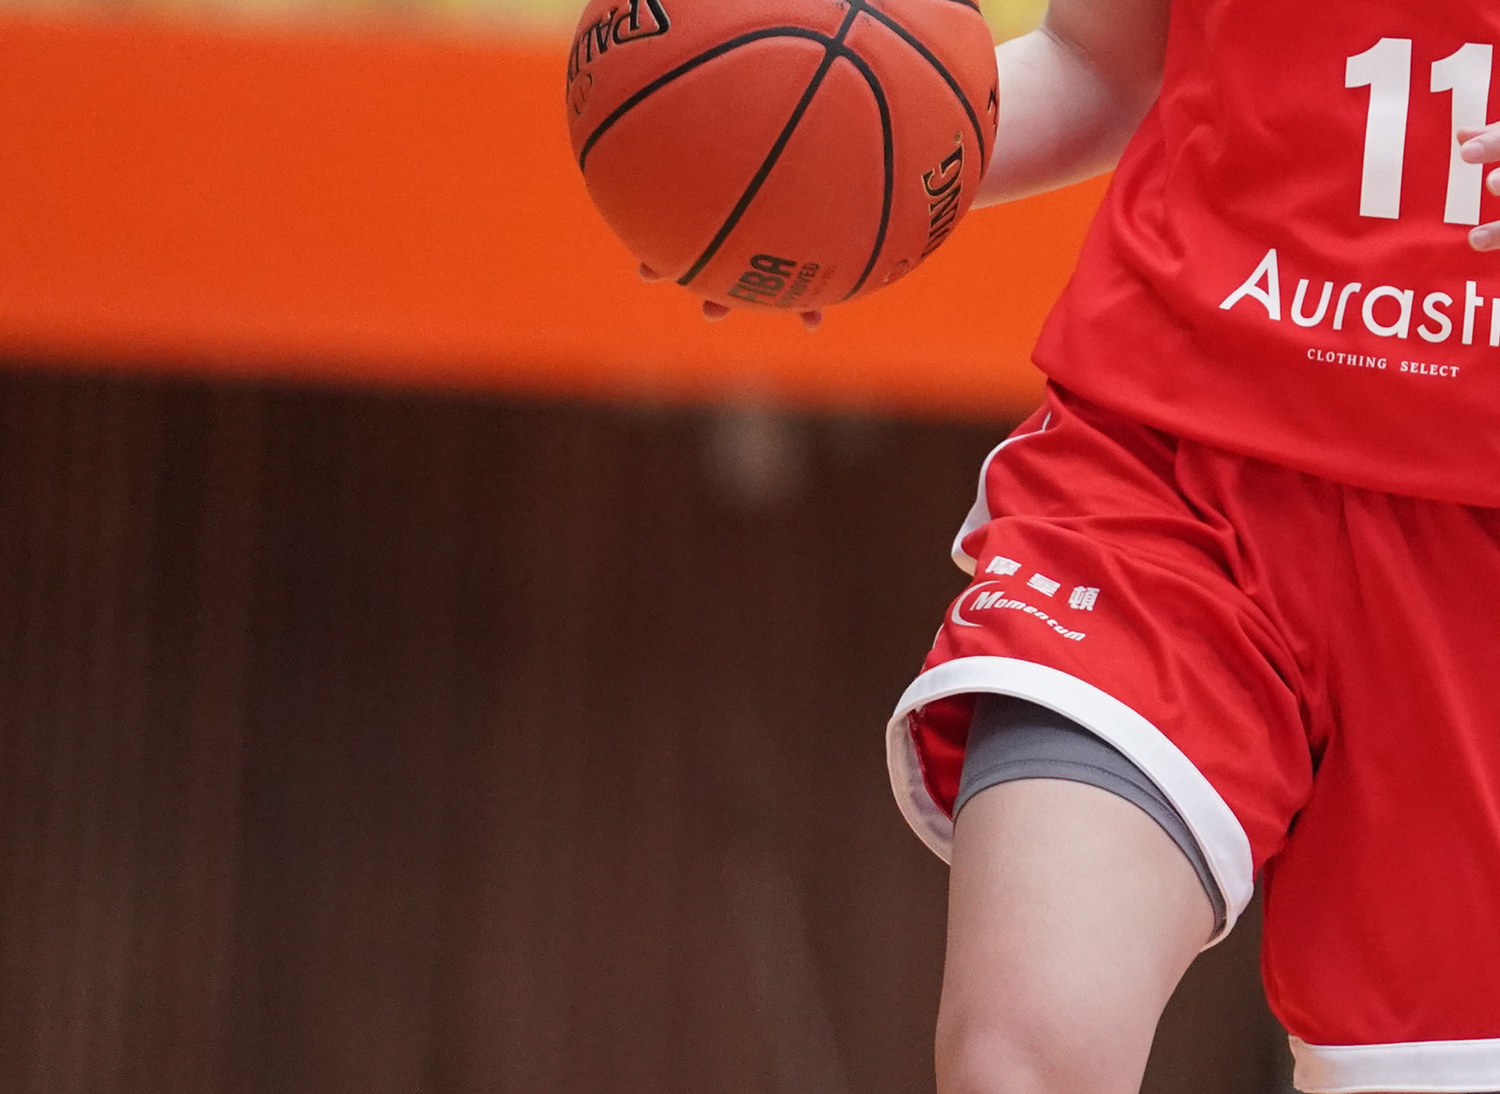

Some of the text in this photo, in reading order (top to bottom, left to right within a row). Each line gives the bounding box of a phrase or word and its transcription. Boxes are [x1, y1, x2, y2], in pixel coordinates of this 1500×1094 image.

[1345, 37, 1494, 226] 11
[728, 253, 796, 305] FIBA
[1307, 348, 1460, 378] CLOTHING SELECT
